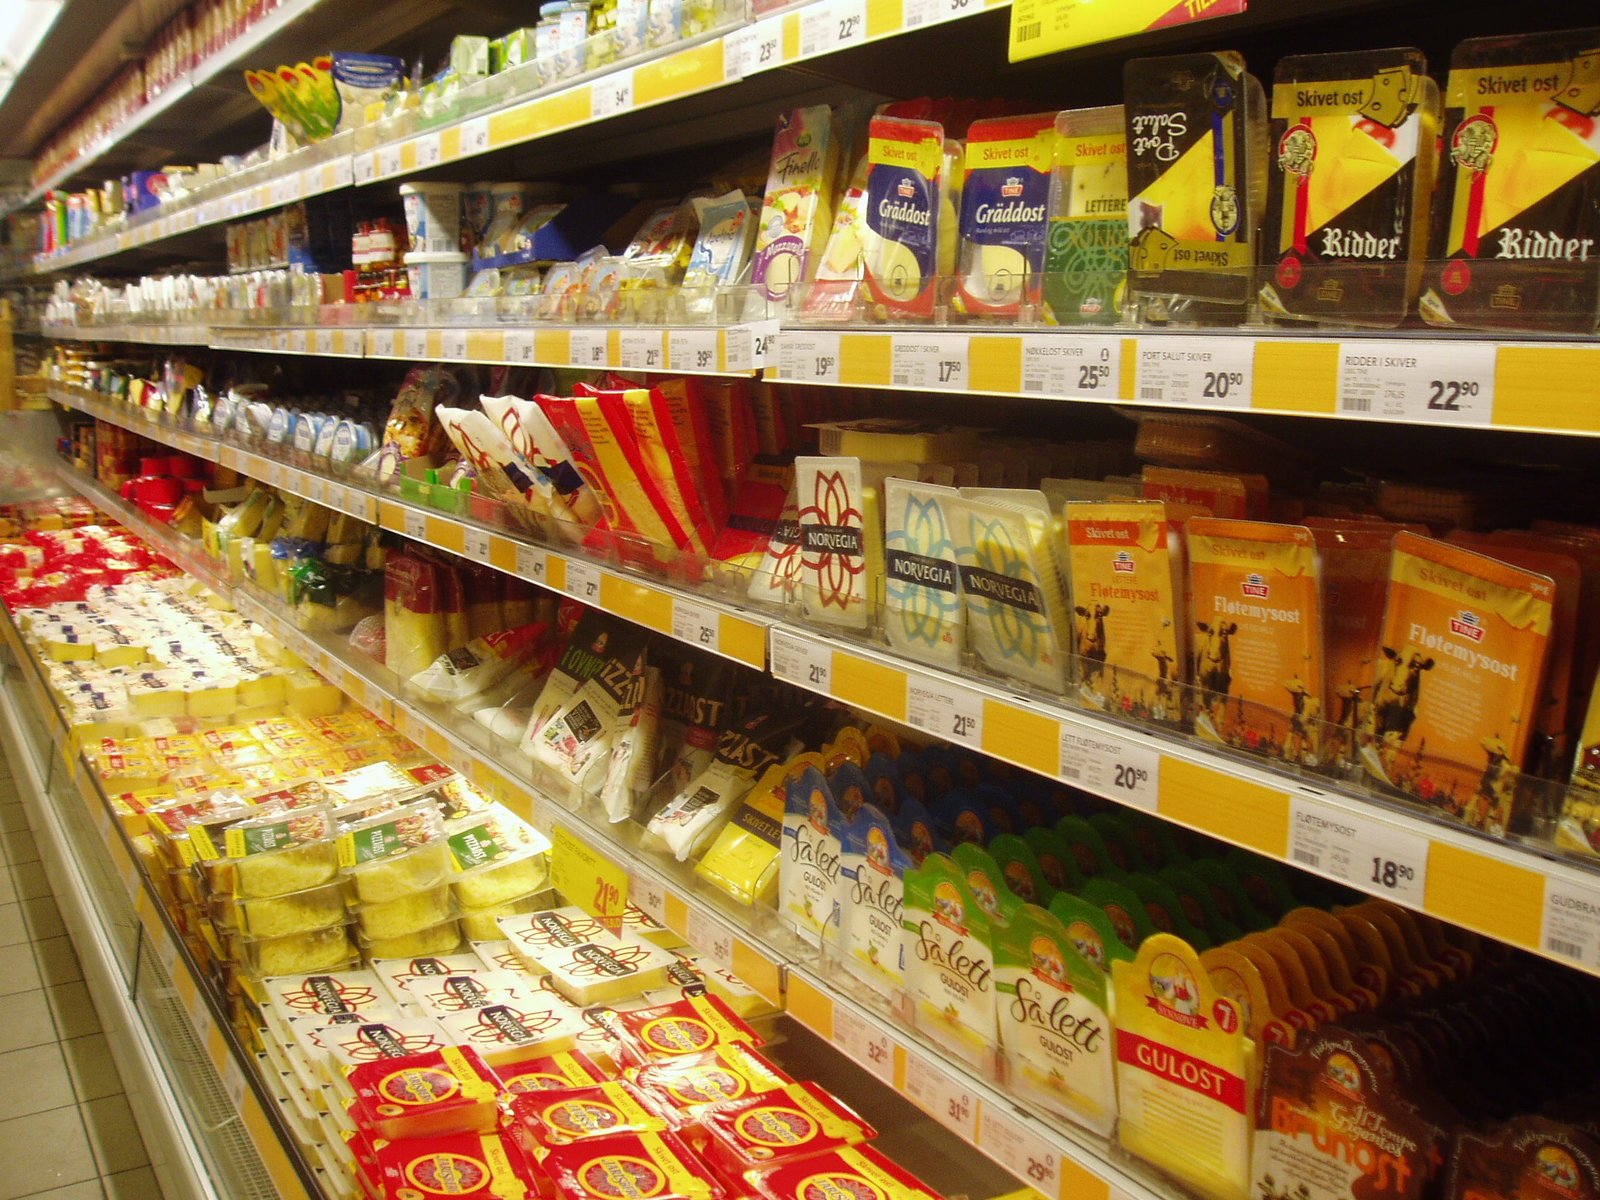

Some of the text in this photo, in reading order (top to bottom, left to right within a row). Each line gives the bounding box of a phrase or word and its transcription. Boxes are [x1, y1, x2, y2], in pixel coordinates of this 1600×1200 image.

[1477, 75, 1559, 95] Skivet ost
[1296, 91, 1364, 109] Skivet ost
[1132, 112, 1188, 136] Salut
[984, 147, 1029, 161] Skivet ost
[1076, 143, 1108, 157] Skivet
[879, 198, 931, 226] Gräddost
[975, 201, 1046, 224] Gräddost
[1085, 198, 1127, 213] LETTERE
[1321, 227, 1401, 260] Ridder
[1497, 228, 1594, 262] Ridder
[1174, 249, 1229, 267] Skivet ost
[1142, 351, 1160, 360] PORT
[1345, 356, 1377, 366] RIDDER
[1385, 357, 1417, 368] SKIVER
[808, 532, 858, 550] NORVEGIA
[1085, 527, 1114, 539] Skivet
[1212, 544, 1247, 560] Skivet
[894, 558, 952, 586] NORVEGIA
[1419, 567, 1466, 594] Skivet
[969, 574, 1036, 606] NORVEGIA
[1090, 582, 1160, 604] Fløtemysost
[1244, 585, 1267, 597] TINE
[1214, 595, 1301, 625] Fløtemysost
[1453, 621, 1484, 641] TINE
[1409, 622, 1519, 682] Fløtemysost
[1296, 811, 1357, 838] FLØTEMYSOST
[542, 917, 577, 947] NORVEGIA
[869, 913, 892, 936] GULOST
[583, 948, 625, 976] NORVEGIA
[915, 920, 993, 993] Sålett
[940, 973, 970, 997] GULOST
[1010, 977, 1105, 1054] Sålett
[1217, 1004, 1233, 1030] 7
[369, 1030, 406, 1058] NORVEG
[1039, 1035, 1074, 1063] GULOST
[1137, 1044, 1226, 1097] GULOST
